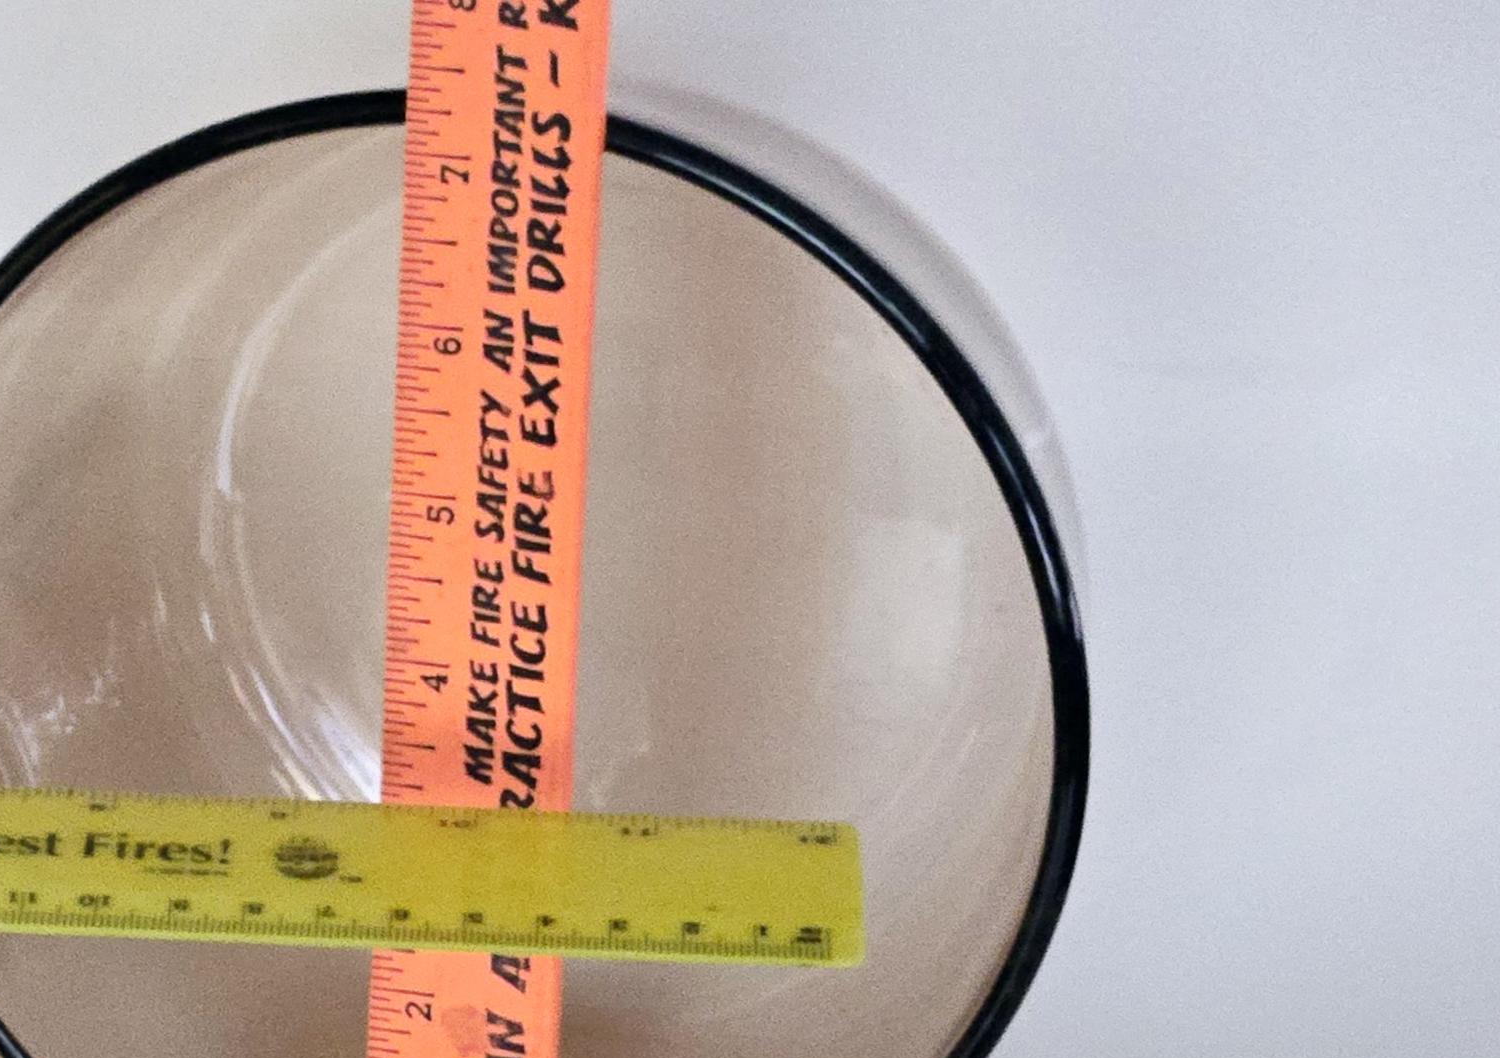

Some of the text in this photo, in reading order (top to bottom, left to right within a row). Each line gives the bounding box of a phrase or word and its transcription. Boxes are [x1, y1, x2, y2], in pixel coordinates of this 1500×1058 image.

[440, 165, 470, 184] 7
[486, 44, 530, 294] IMPORTANT
[526, 112, 573, 293] DRILLS
[433, 337, 462, 356] 6
[482, 309, 516, 373] AN
[520, 309, 563, 449] EXIT
[474, 388, 511, 543] SAFETY
[426, 506, 456, 525] 5
[511, 470, 556, 586] FIRE
[470, 558, 505, 647] FIRE
[420, 673, 449, 693] 4
[463, 659, 499, 785] MAKE
[499, 601, 548, 809] RACTICE
[83, 831, 233, 866] Fires!
[405, 1001, 433, 1023] 2
